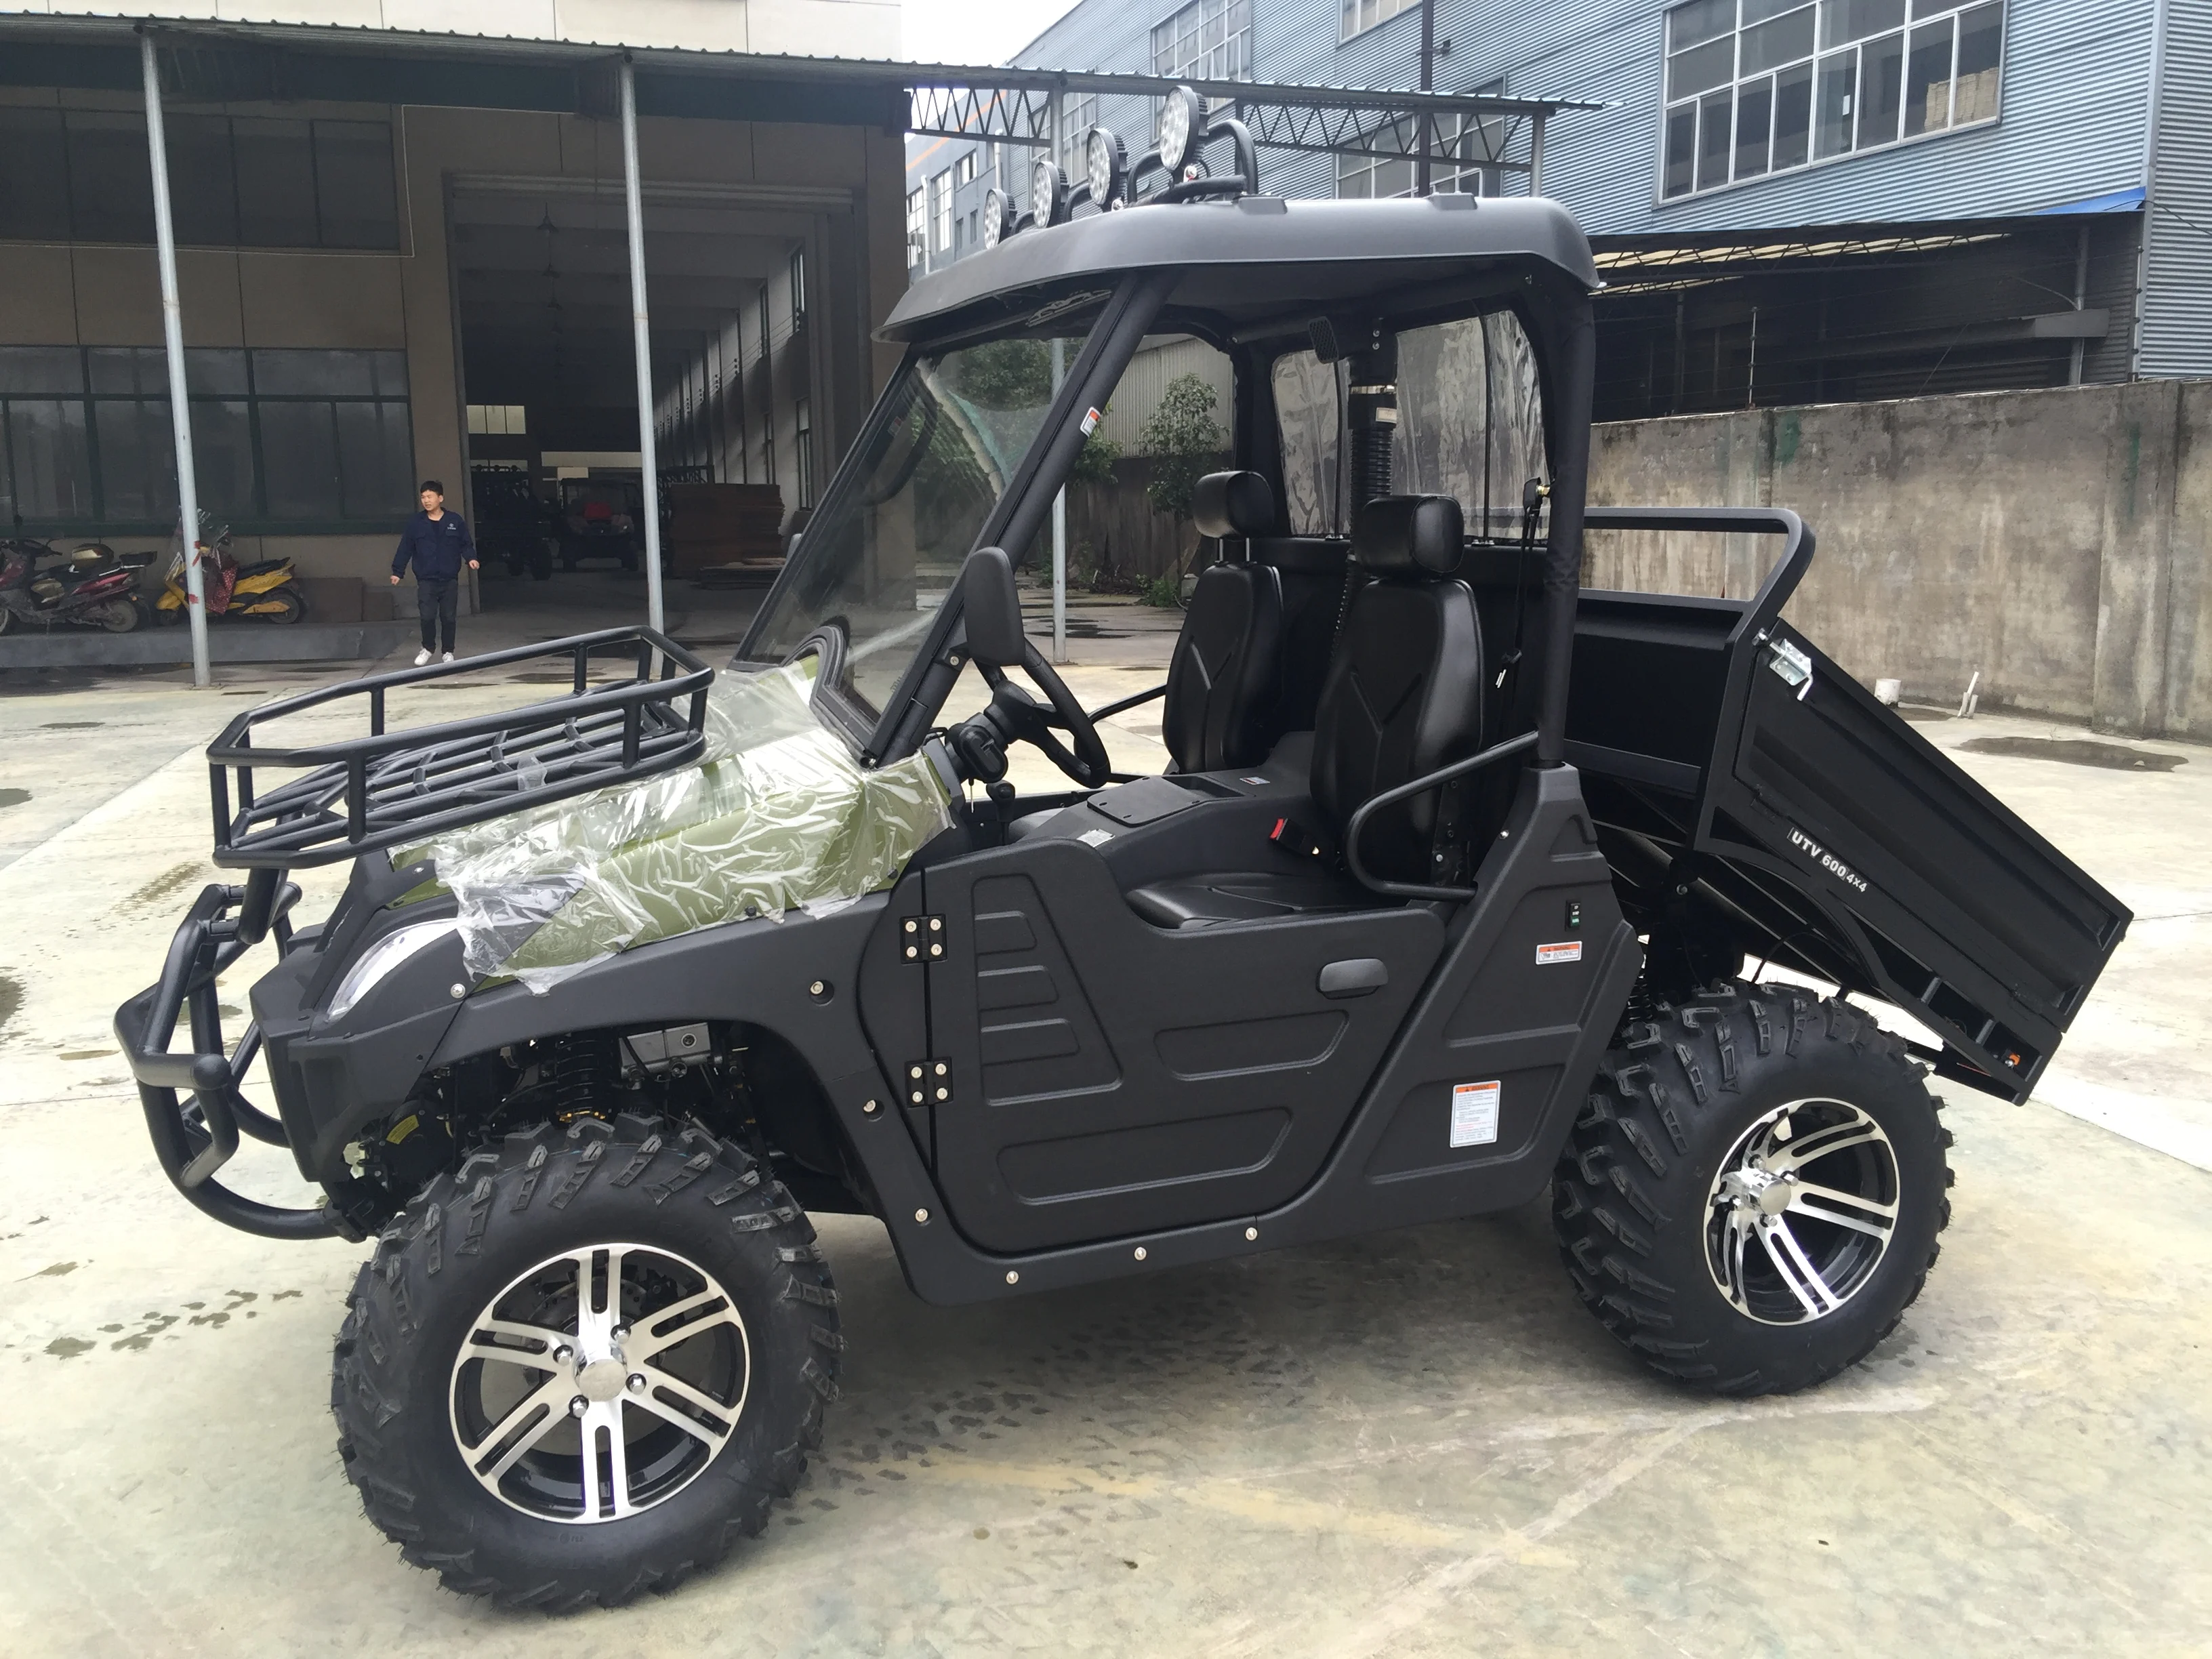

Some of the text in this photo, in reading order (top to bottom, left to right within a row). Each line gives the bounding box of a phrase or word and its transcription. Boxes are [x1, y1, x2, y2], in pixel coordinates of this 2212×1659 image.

[1792, 830, 1868, 893] UTV 600 4x4
